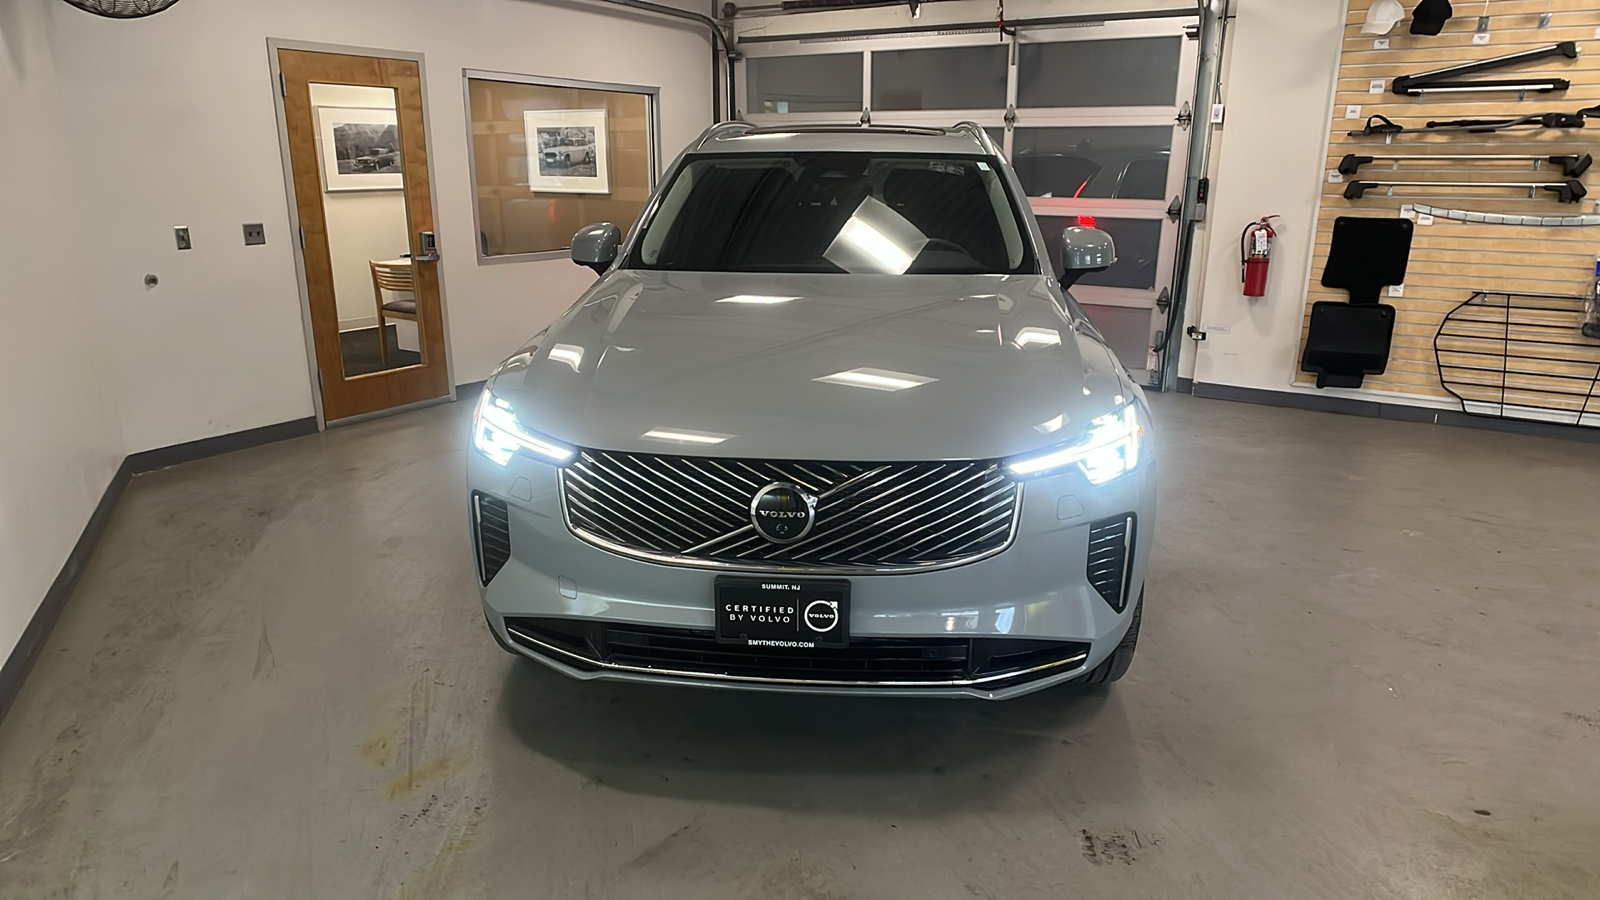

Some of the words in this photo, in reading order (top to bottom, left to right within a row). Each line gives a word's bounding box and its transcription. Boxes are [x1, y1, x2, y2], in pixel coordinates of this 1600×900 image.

[759, 510, 806, 519] VOLVO
[725, 604, 794, 614] CERTIFIED
[729, 613, 744, 621] BY
[750, 614, 790, 623] VOLVO
[748, 639, 815, 648] SMYTHEVOLVO.COM
